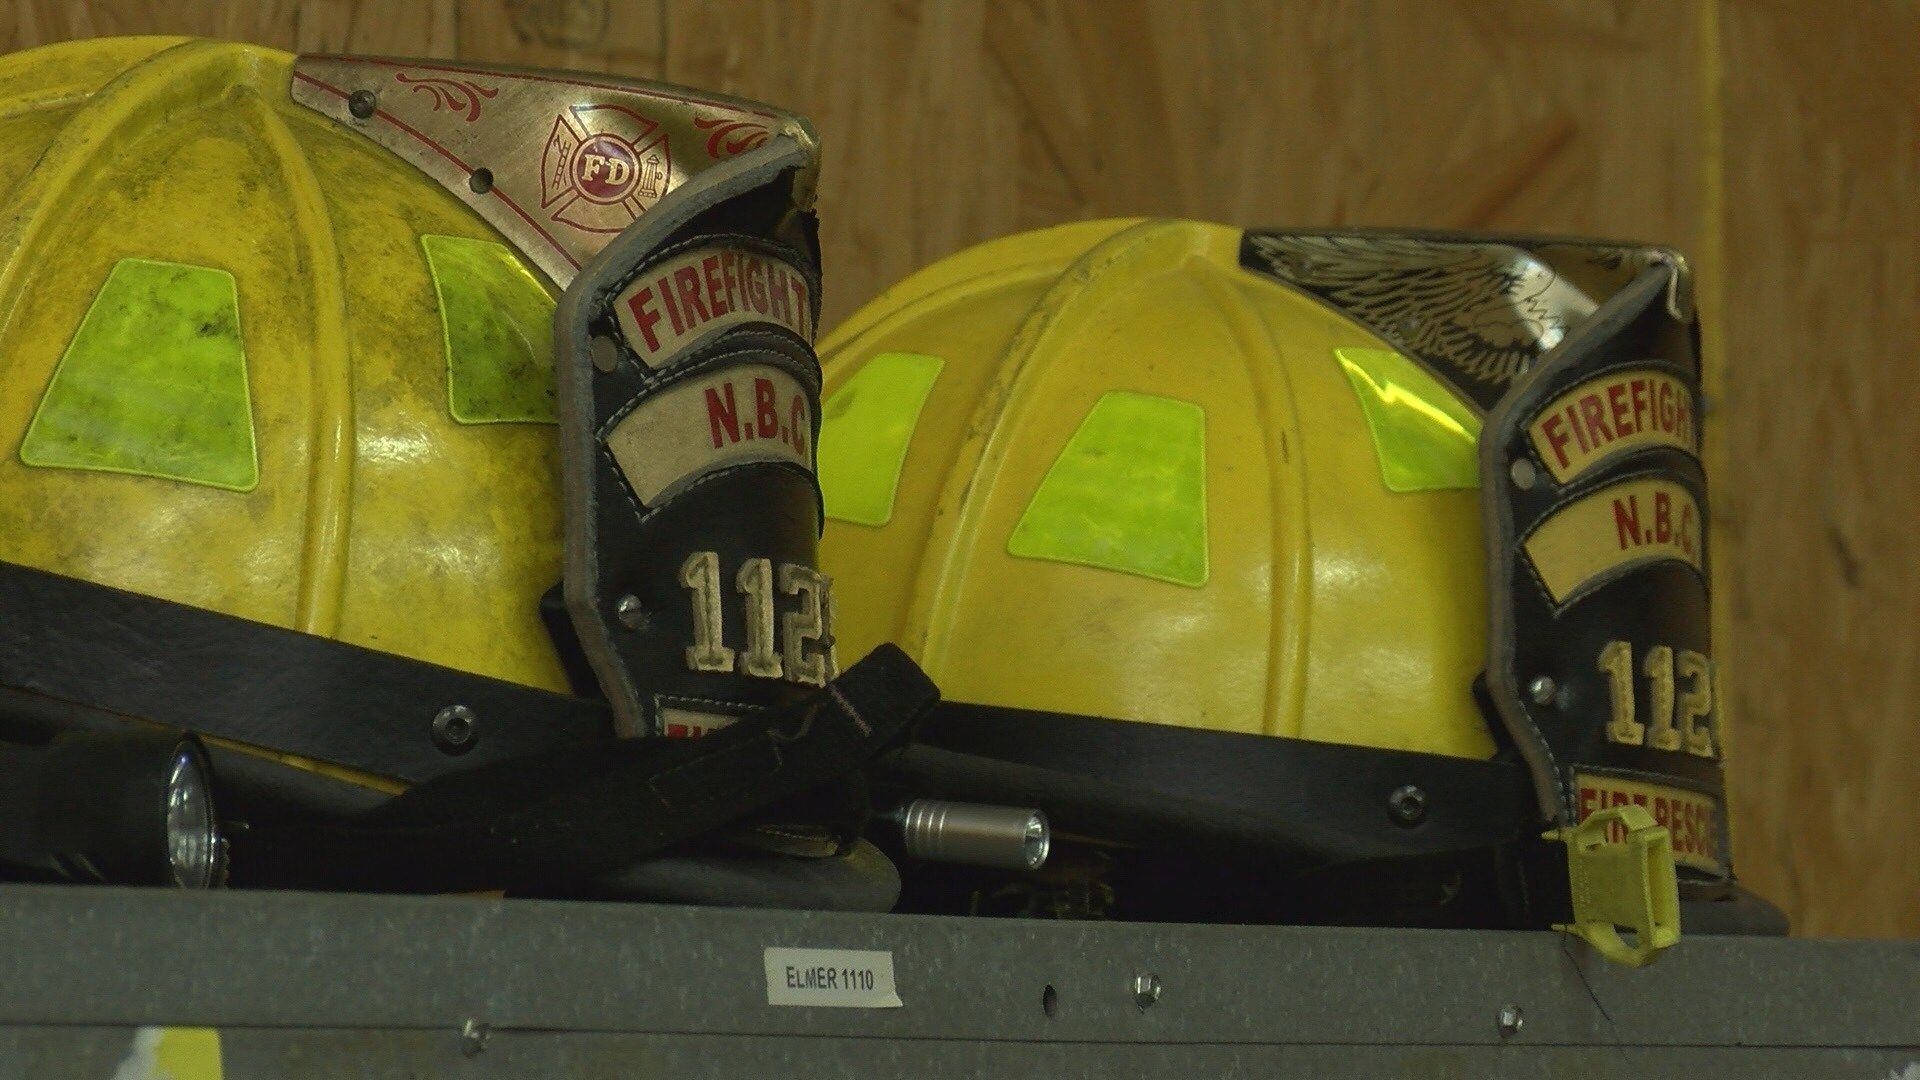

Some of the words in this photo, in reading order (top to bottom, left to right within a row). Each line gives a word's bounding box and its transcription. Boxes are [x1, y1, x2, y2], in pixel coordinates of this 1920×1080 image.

[582, 155, 629, 185] FD
[680, 551, 838, 687] 112
[786, 966, 837, 989] ELMER
[842, 969, 874, 990] 1110
